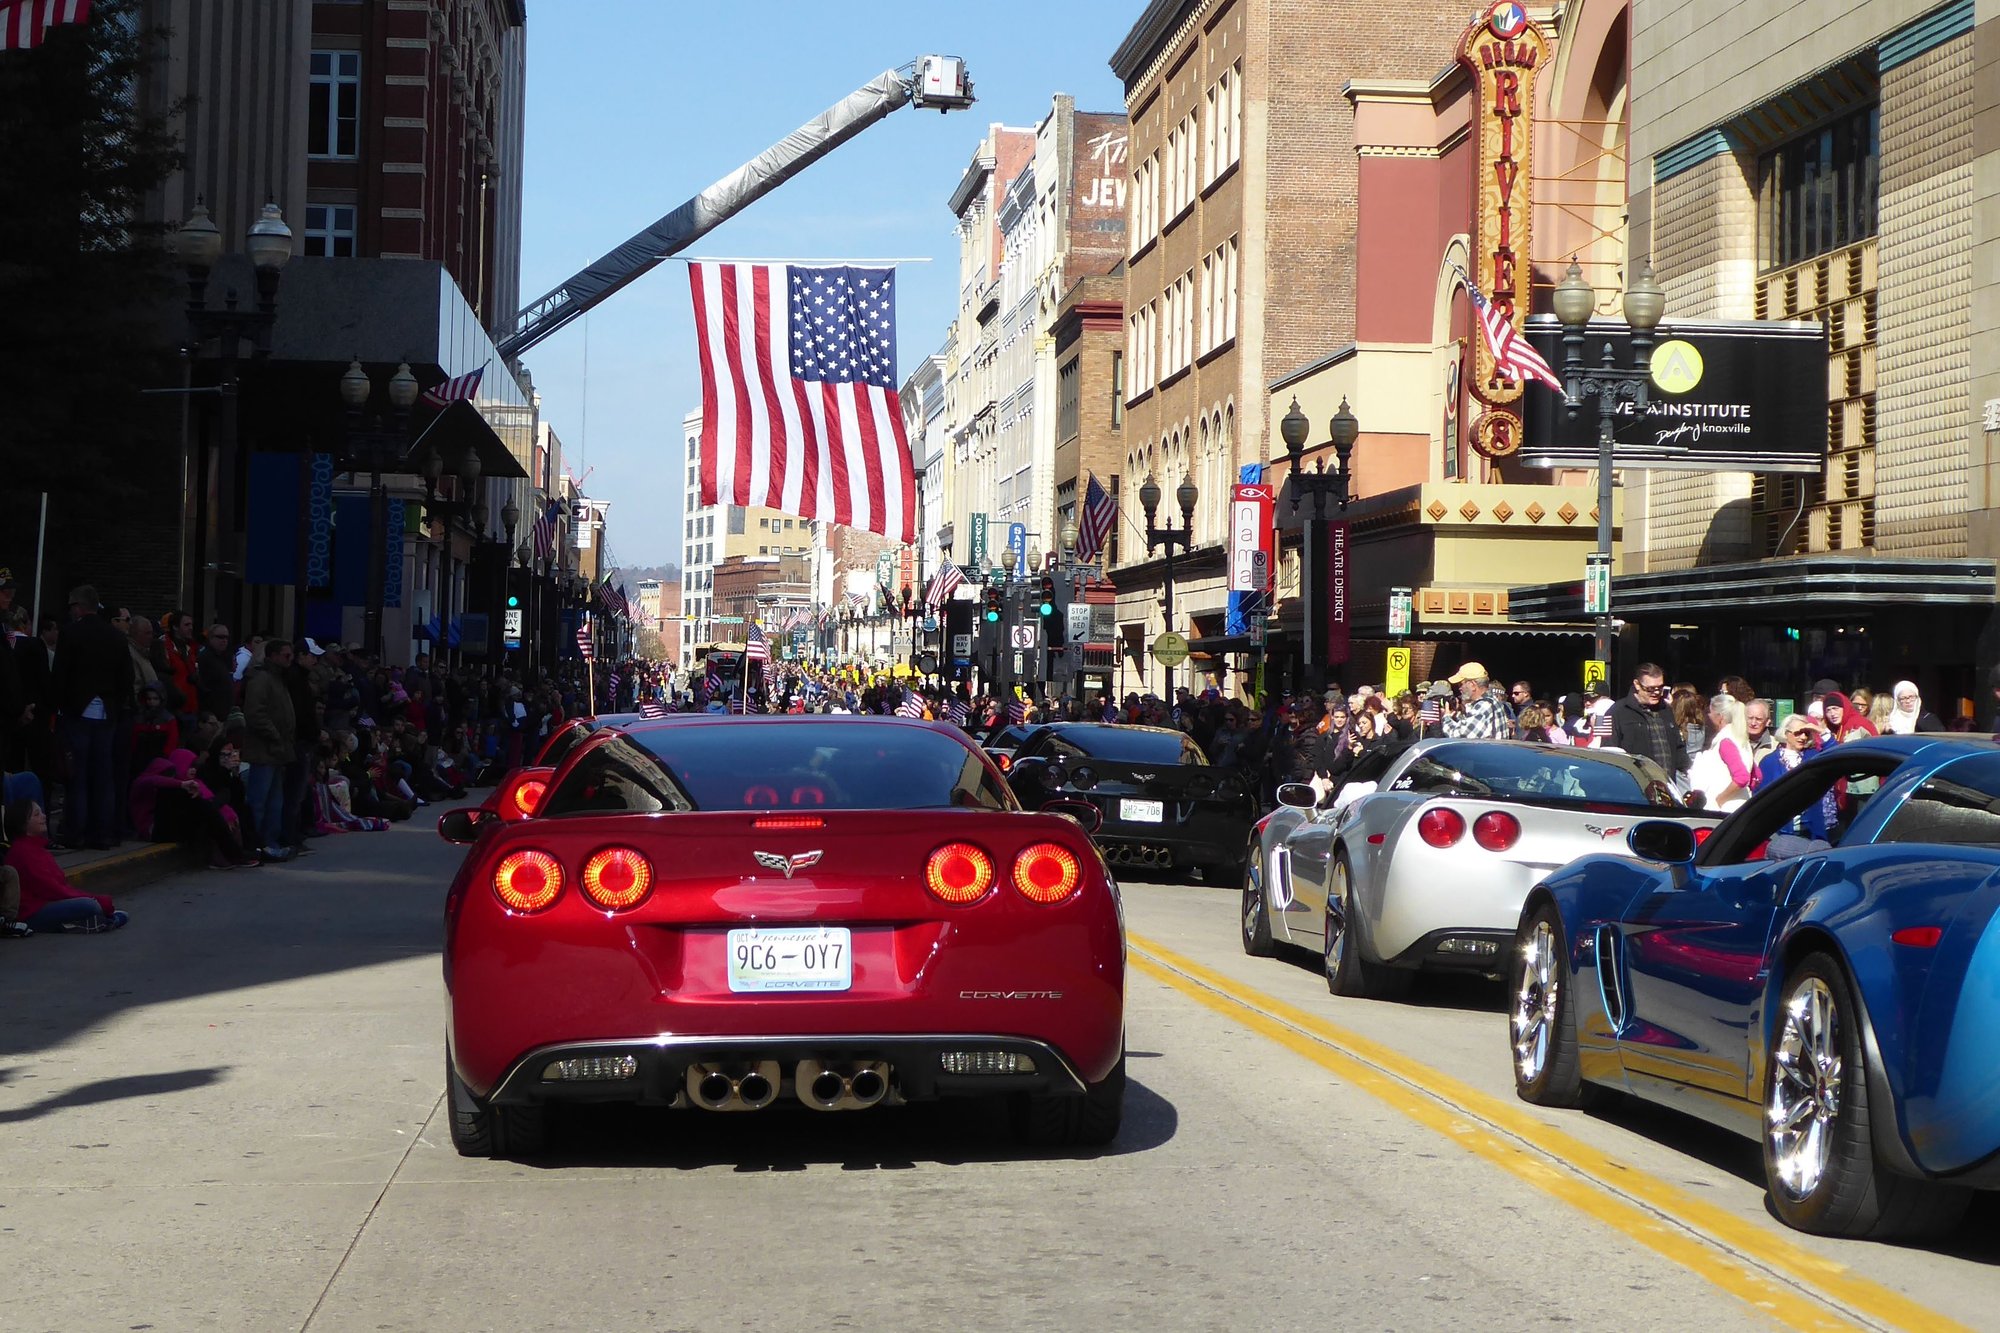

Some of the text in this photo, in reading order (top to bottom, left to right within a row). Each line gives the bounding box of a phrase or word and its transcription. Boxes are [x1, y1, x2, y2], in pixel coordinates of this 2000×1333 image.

[1479, 40, 1537, 70] REGAL
[1663, 403, 1751, 418] INSTITUTE
[1491, 418, 1511, 450] 8
[1702, 422, 1751, 434] knoxville
[975, 517, 985, 564] DOWNTOWN
[1238, 507, 1254, 584] nama
[1334, 527, 1344, 623] THEATRE DISTRICT
[505, 611, 518, 619] ONE
[1071, 607, 1088, 615] STOP
[504, 618, 519, 626] WAY
[1166, 636, 1178, 650] P
[736, 932, 749, 943] OCT
[764, 980, 841, 988] CORVETTE
[959, 990, 1063, 999] CORVETTE
